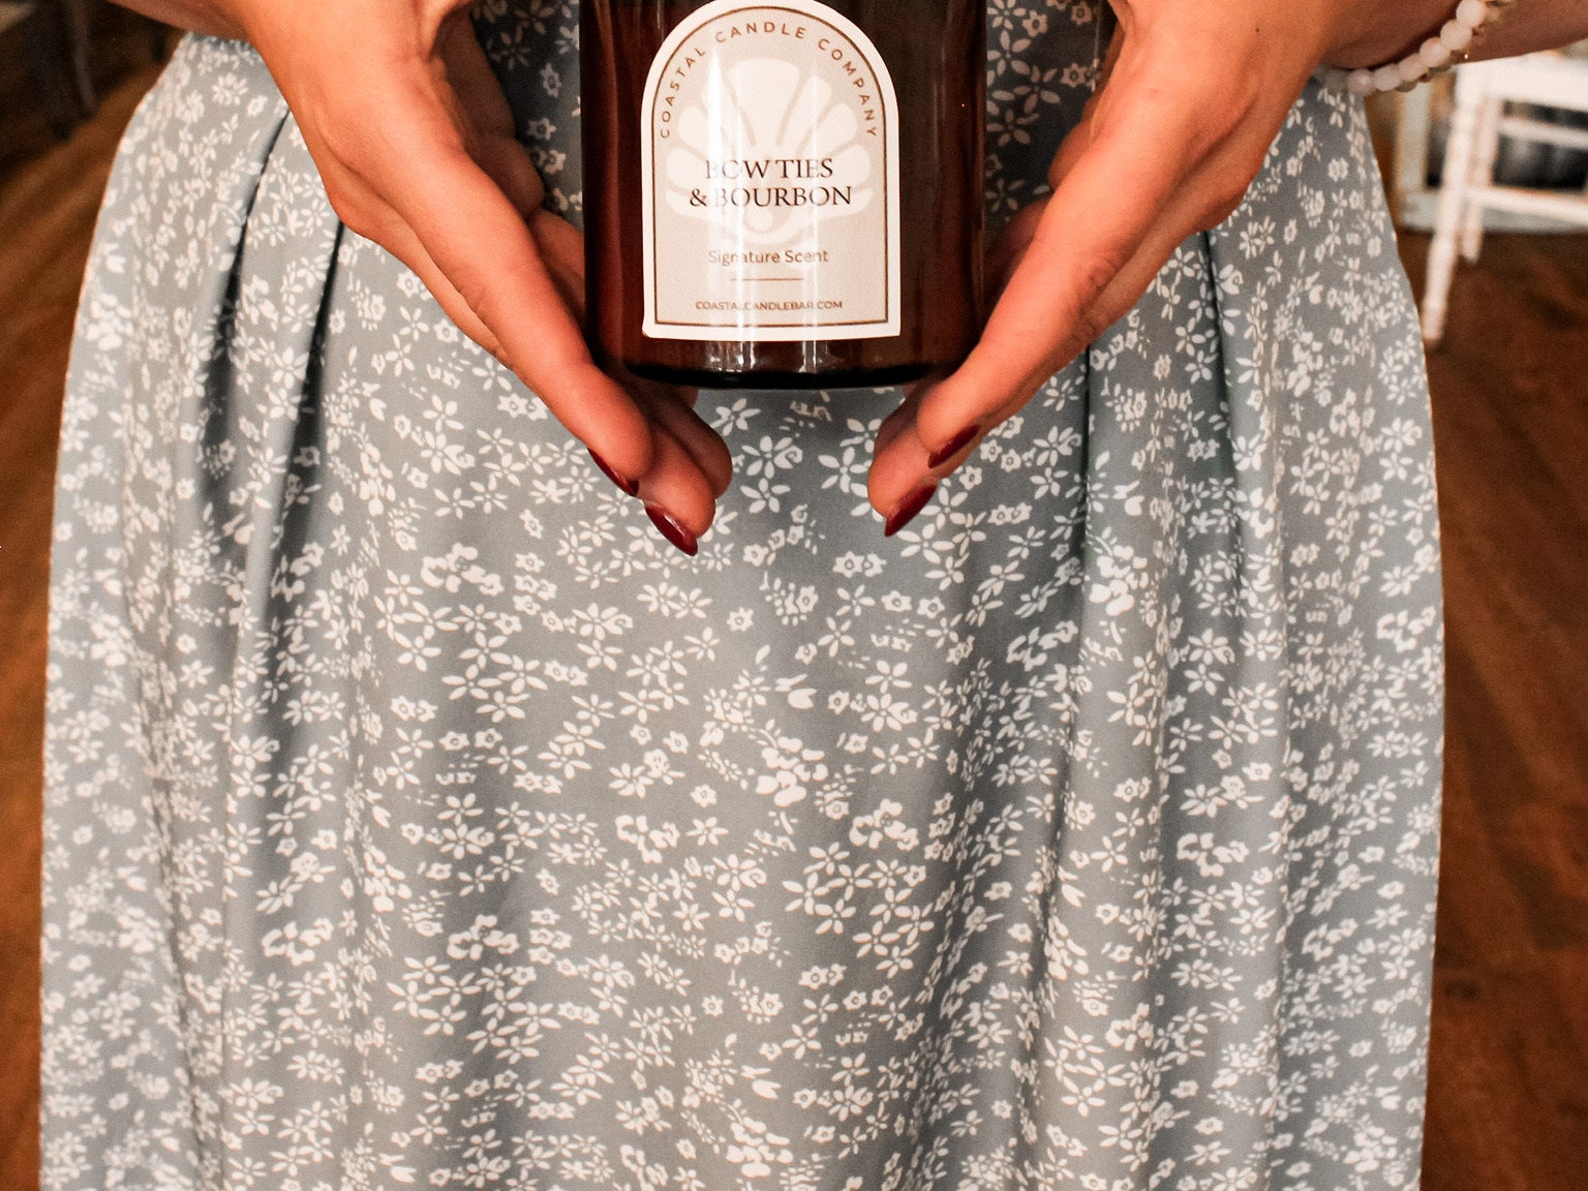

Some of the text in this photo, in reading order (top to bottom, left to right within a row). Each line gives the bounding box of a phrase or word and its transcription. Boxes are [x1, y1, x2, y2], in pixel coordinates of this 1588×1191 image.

[660, 21, 877, 139] COASTAL CANDLE COMPANY
[689, 186, 852, 207] & BOURBON
[784, 250, 829, 263] Scent
